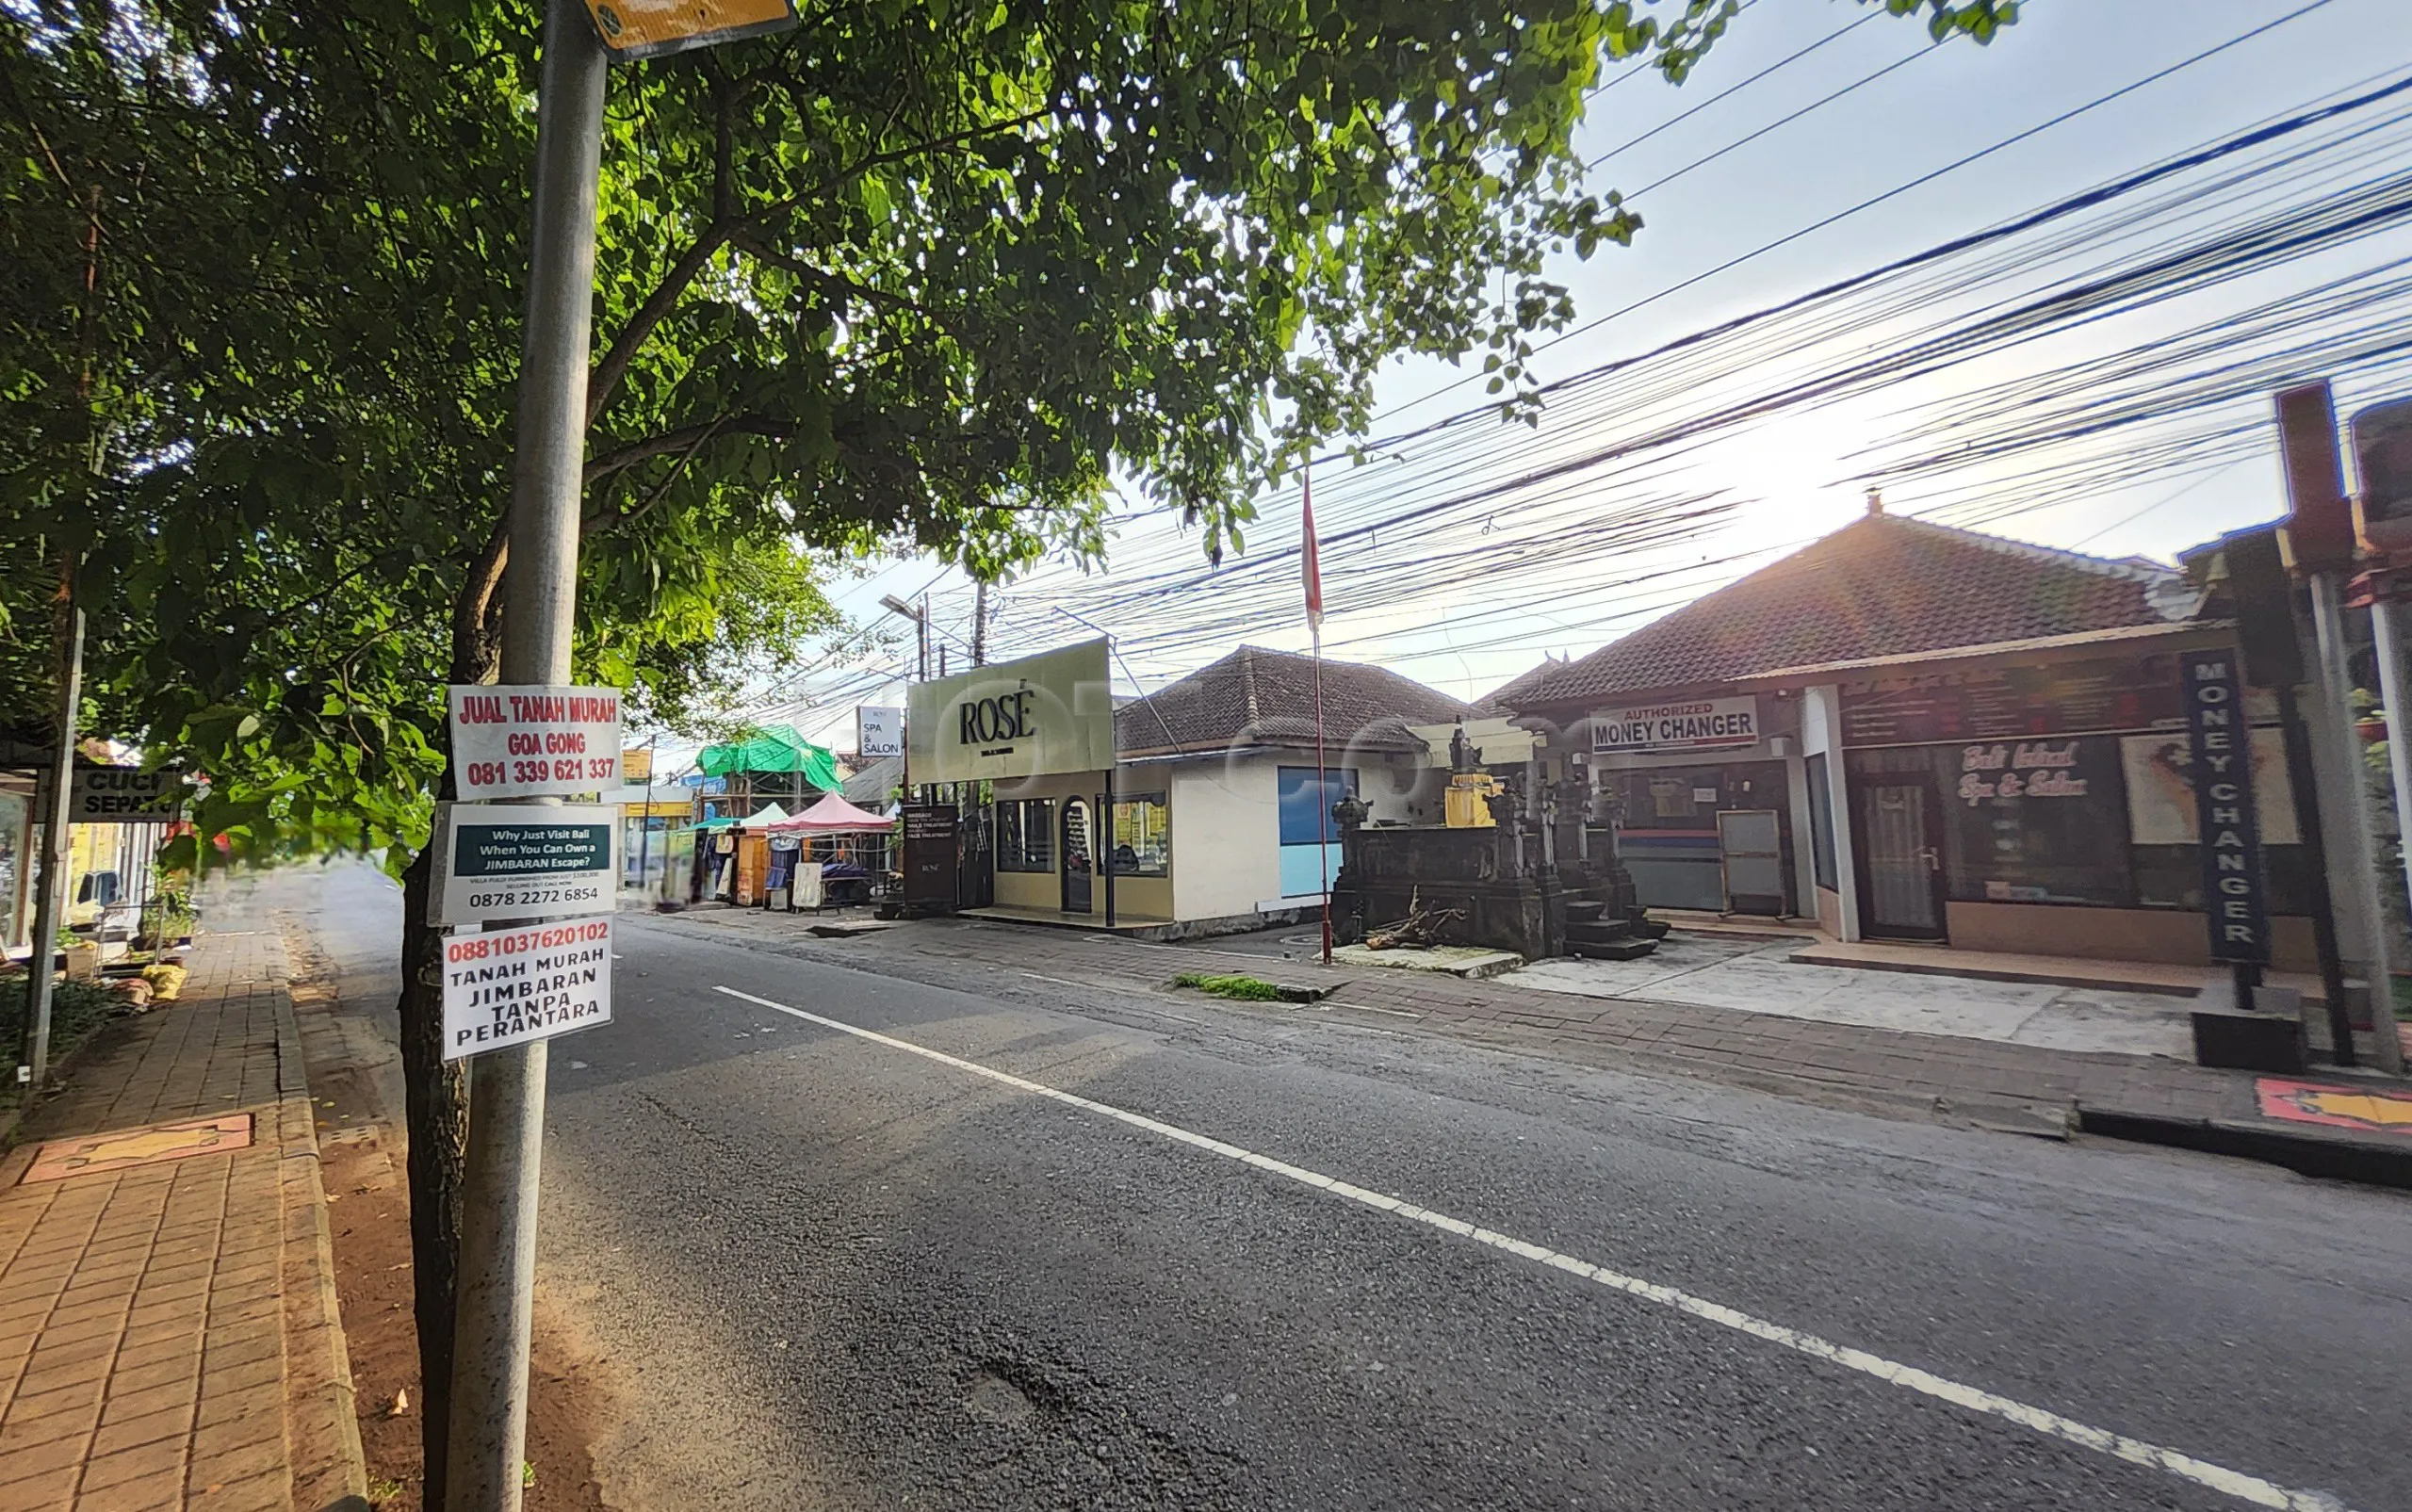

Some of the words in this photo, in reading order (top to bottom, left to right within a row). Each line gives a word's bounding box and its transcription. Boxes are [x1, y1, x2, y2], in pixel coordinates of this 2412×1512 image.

[459, 696, 507, 724] JUAL
[510, 696, 564, 723] TANAH
[569, 697, 617, 723] MURAH
[959, 678, 1036, 744] ROSÉ
[1624, 703, 1713, 721] AUTHORIZED
[2194, 663, 2232, 772] MONEY
[864, 723, 882, 732] SPA
[864, 734, 872, 742] &
[1595, 721, 1654, 745] MONEY
[1660, 713, 1752, 740] CHANGER
[509, 733, 543, 756] GOA
[546, 733, 586, 754] GONG
[864, 744, 899, 753] SALON
[468, 761, 506, 786] 081
[513, 760, 548, 783] 339
[554, 759, 583, 780] 621
[589, 758, 614, 779] 337
[1958, 772, 1996, 806] Spa
[1997, 772, 2026, 797] &
[480, 845, 516, 855] When
[519, 845, 540, 854] You
[543, 844, 562, 854] Can
[565, 843, 587, 854] Own
[589, 844, 596, 853] a
[492, 831, 520, 842] Why
[522, 830, 545, 840] Just
[547, 830, 569, 839] Visit
[572, 829, 591, 838] Bali
[484, 858, 548, 870] JIMBARAN
[551, 856, 591, 869] Escape?
[2209, 784, 2255, 943] CHANGER
[470, 893, 515, 907] 0878
[520, 890, 560, 904] 2272
[564, 887, 598, 902] 6854
[448, 922, 608, 964] 0881037620102
[450, 962, 526, 986] TANAH
[536, 948, 604, 972] MURAH
[468, 967, 596, 1007] JIMBARAN
[491, 992, 571, 1022] TANPA
[456, 1000, 599, 1046] PERANTARA
